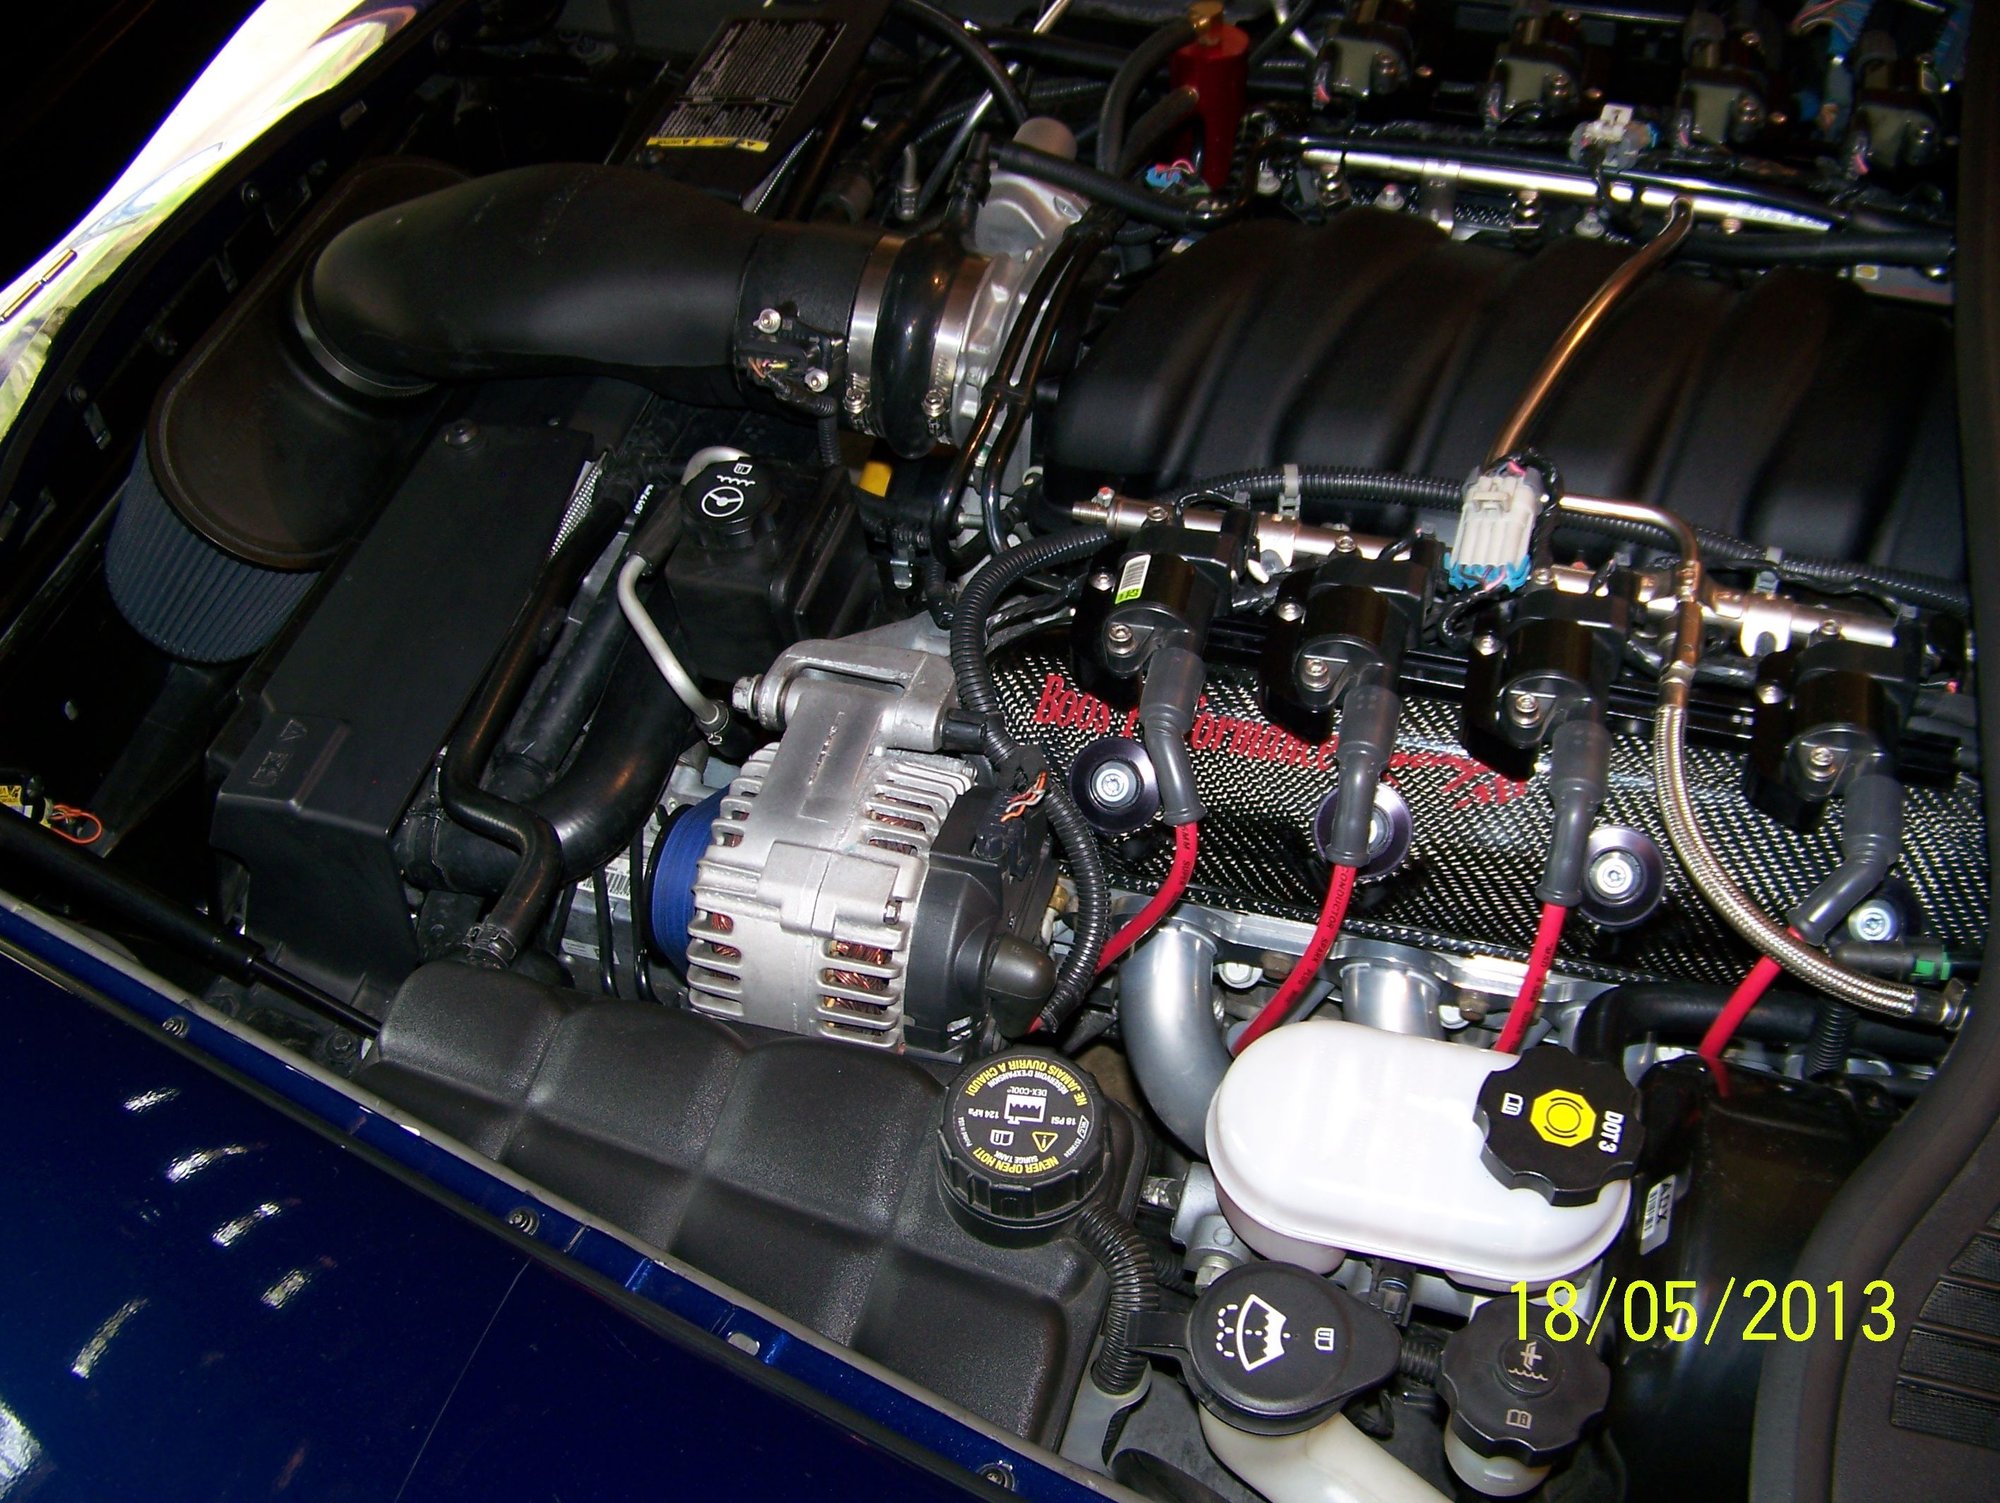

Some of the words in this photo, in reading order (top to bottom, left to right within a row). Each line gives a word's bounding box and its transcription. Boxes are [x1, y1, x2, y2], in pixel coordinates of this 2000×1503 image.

[1033, 673, 1111, 734] Boos
[1312, 937, 1329, 963] SPARK
[1007, 1059, 1047, 1071] OUVRIR
[965, 1067, 998, 1097] CHAUD!
[1048, 1065, 1081, 1094] JAMAIS
[1076, 1090, 1088, 1107] NE
[968, 1108, 984, 1117] kPa
[984, 1109, 999, 1119] 124
[1050, 1116, 1065, 1125] PSI
[1066, 1116, 1077, 1125] 18
[972, 1147, 996, 1167] HOT!
[994, 1150, 1013, 1164] TANK
[1014, 1154, 1038, 1164] SURGE
[1025, 1155, 1059, 1174] NEVER
[995, 1160, 1023, 1174] OPEN
[1656, 1182, 1673, 1225] AUX
